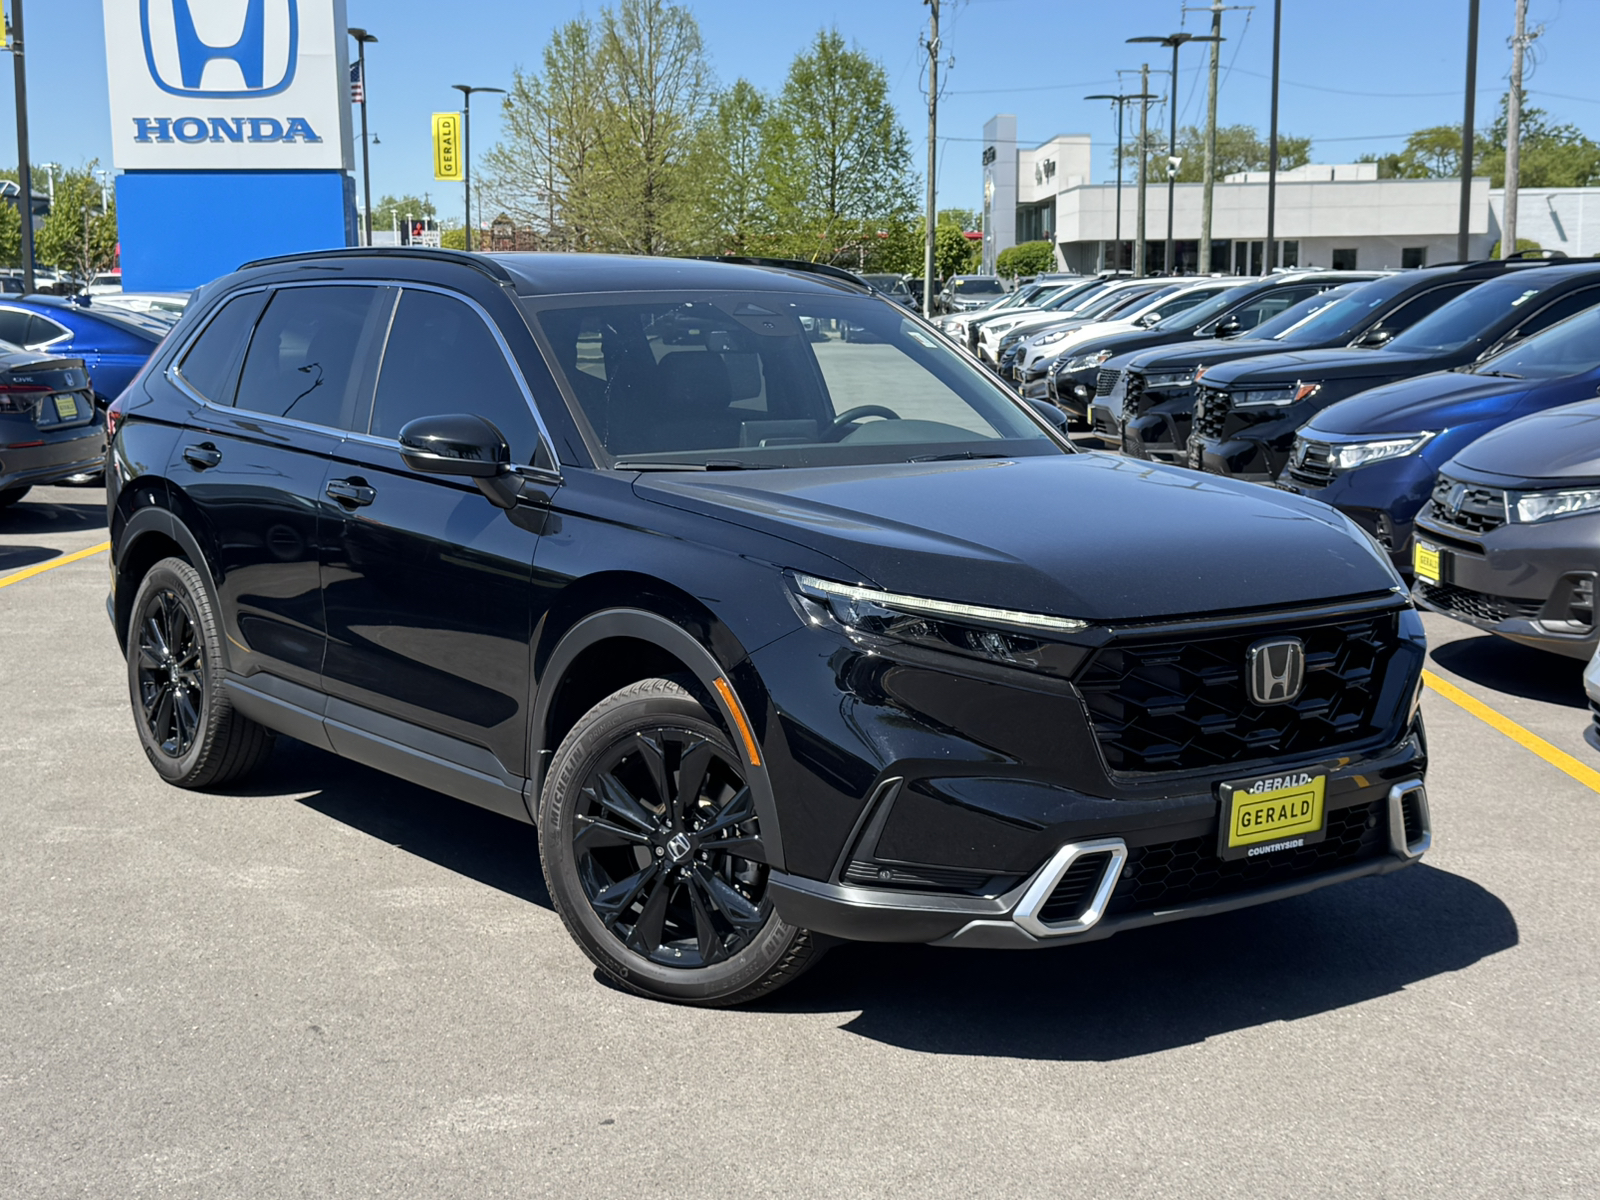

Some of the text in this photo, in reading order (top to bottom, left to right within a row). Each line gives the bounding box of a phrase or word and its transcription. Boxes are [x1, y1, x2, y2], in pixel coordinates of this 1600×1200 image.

[132, 117, 323, 144] HONDA
[442, 121, 453, 172] GERALD
[588, 715, 623, 742] PRIMACY
[551, 746, 584, 827] MICHELIN
[1254, 773, 1309, 793] GERALD
[1242, 801, 1309, 828] GERALD
[1247, 838, 1304, 857] COUNTRYSIDE
